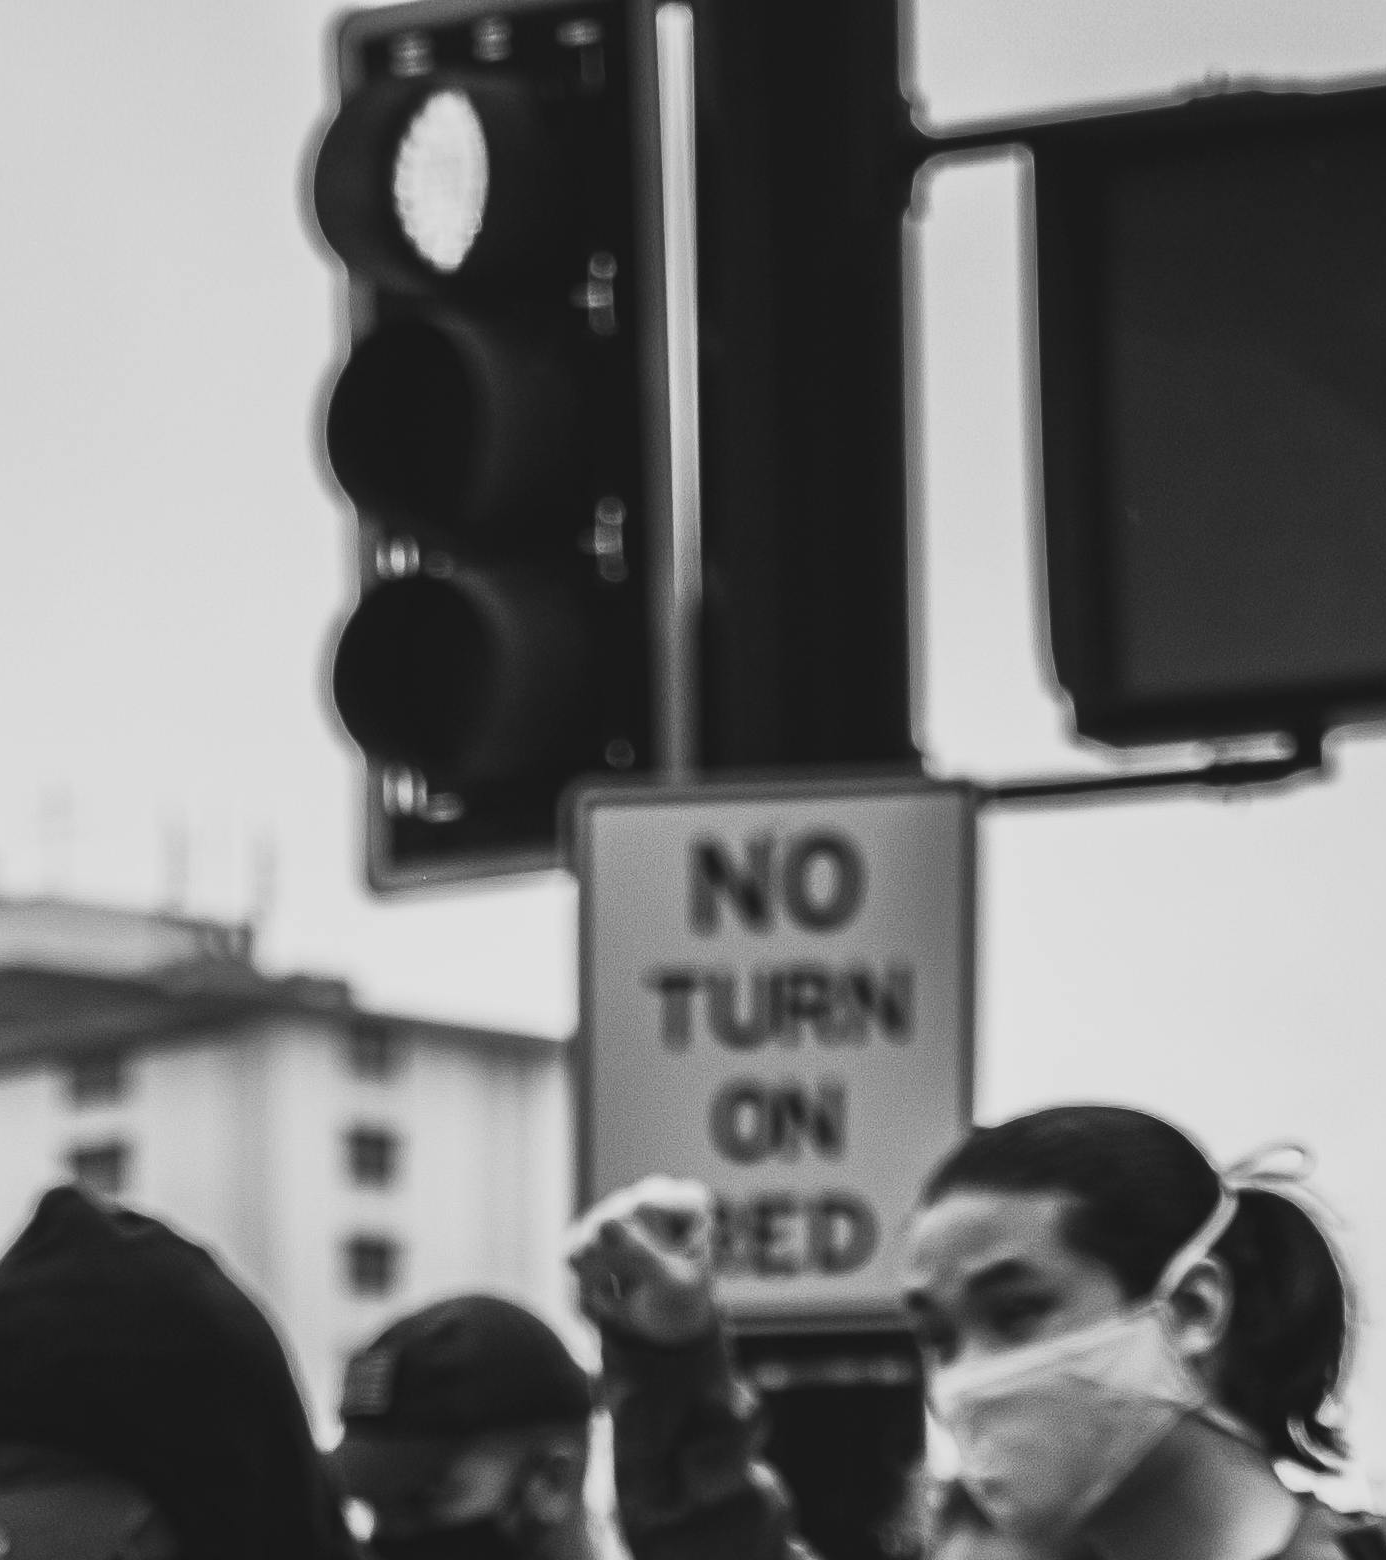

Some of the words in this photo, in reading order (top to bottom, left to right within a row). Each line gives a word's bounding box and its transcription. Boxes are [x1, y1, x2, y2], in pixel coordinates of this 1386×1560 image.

[688, 829, 869, 935] NO
[643, 962, 913, 1053] TURN
[710, 1078, 846, 1166] ON
